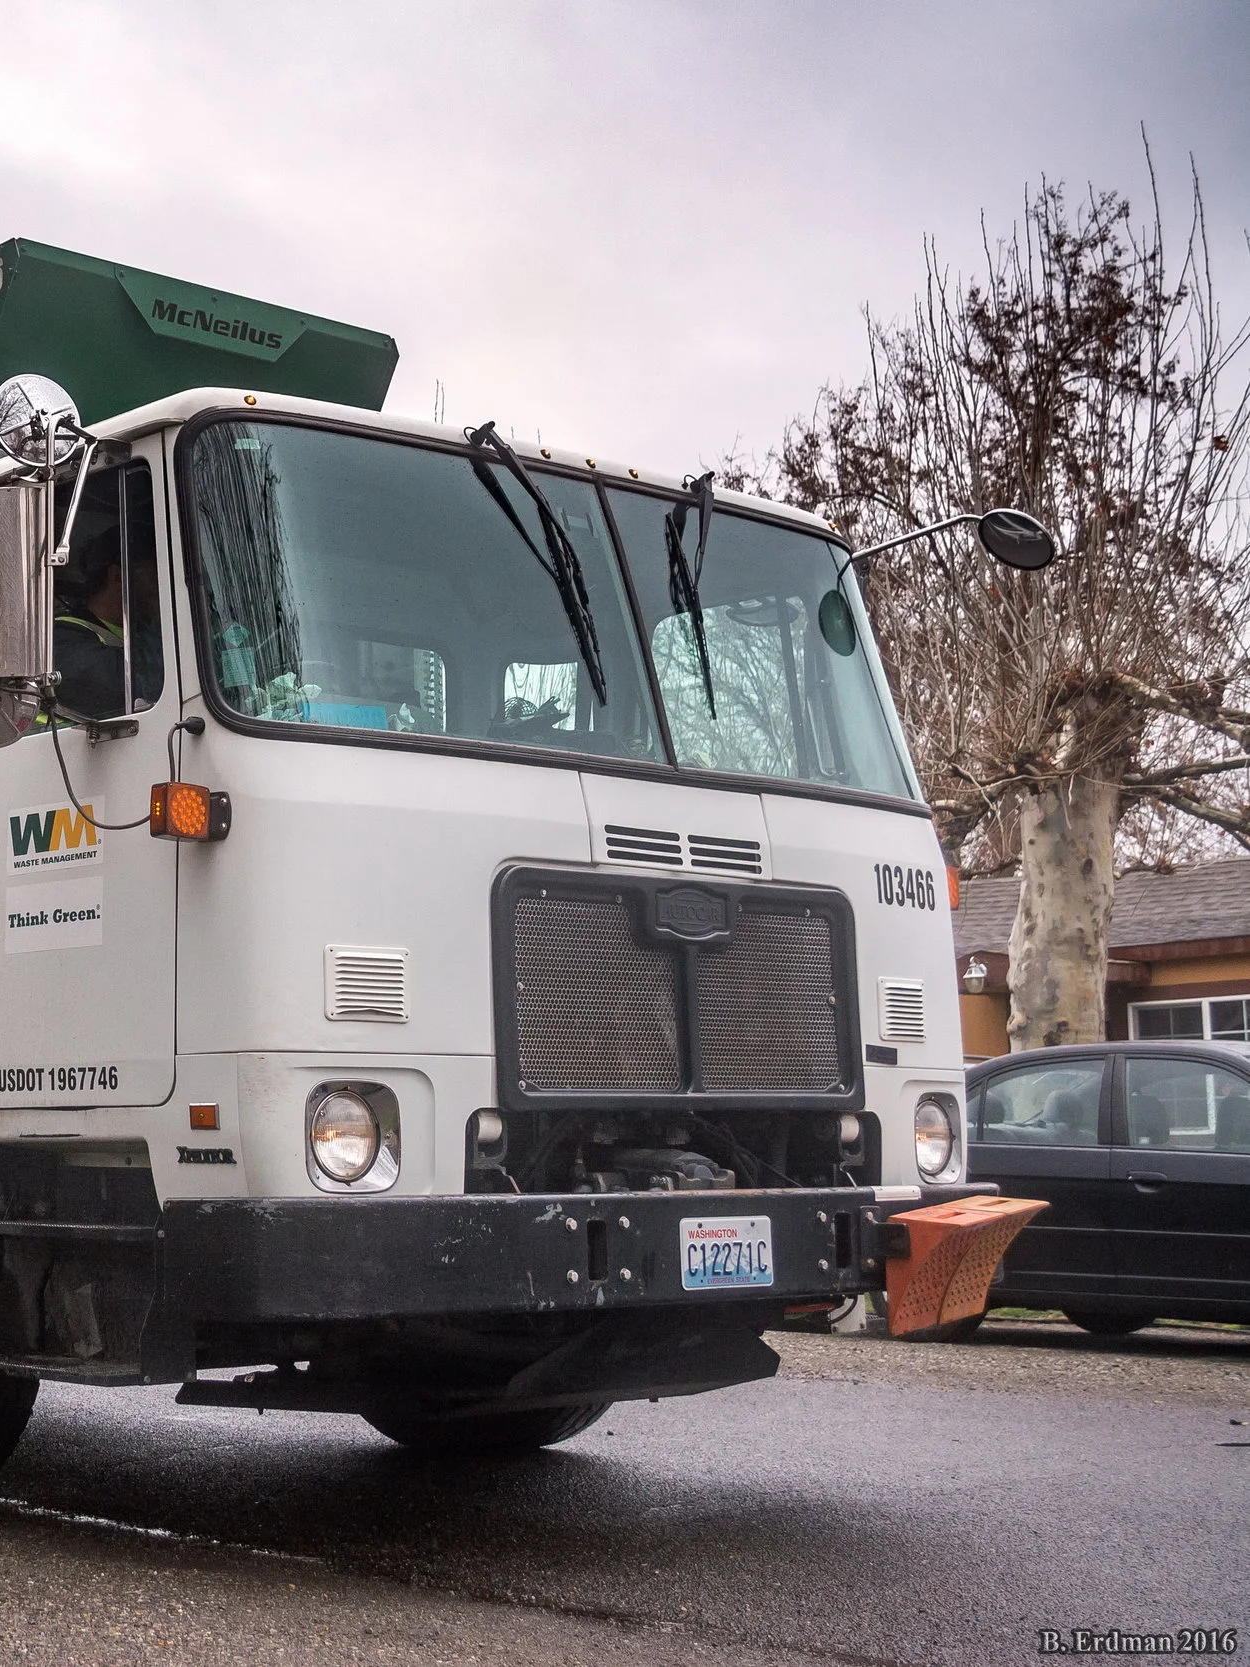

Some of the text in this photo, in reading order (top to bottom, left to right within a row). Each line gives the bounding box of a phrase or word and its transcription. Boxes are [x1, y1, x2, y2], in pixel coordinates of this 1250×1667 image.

[151, 298, 283, 350] McNeilus
[9, 803, 99, 857] WM
[13, 850, 98, 869] WASTE MANAGEMENT
[873, 863, 936, 912] 103466
[8, 908, 101, 929] Think Green.
[48, 1066, 119, 1092] 1967746
[687, 1228, 738, 1240] WASHINGTON
[687, 1240, 768, 1277] C12271C
